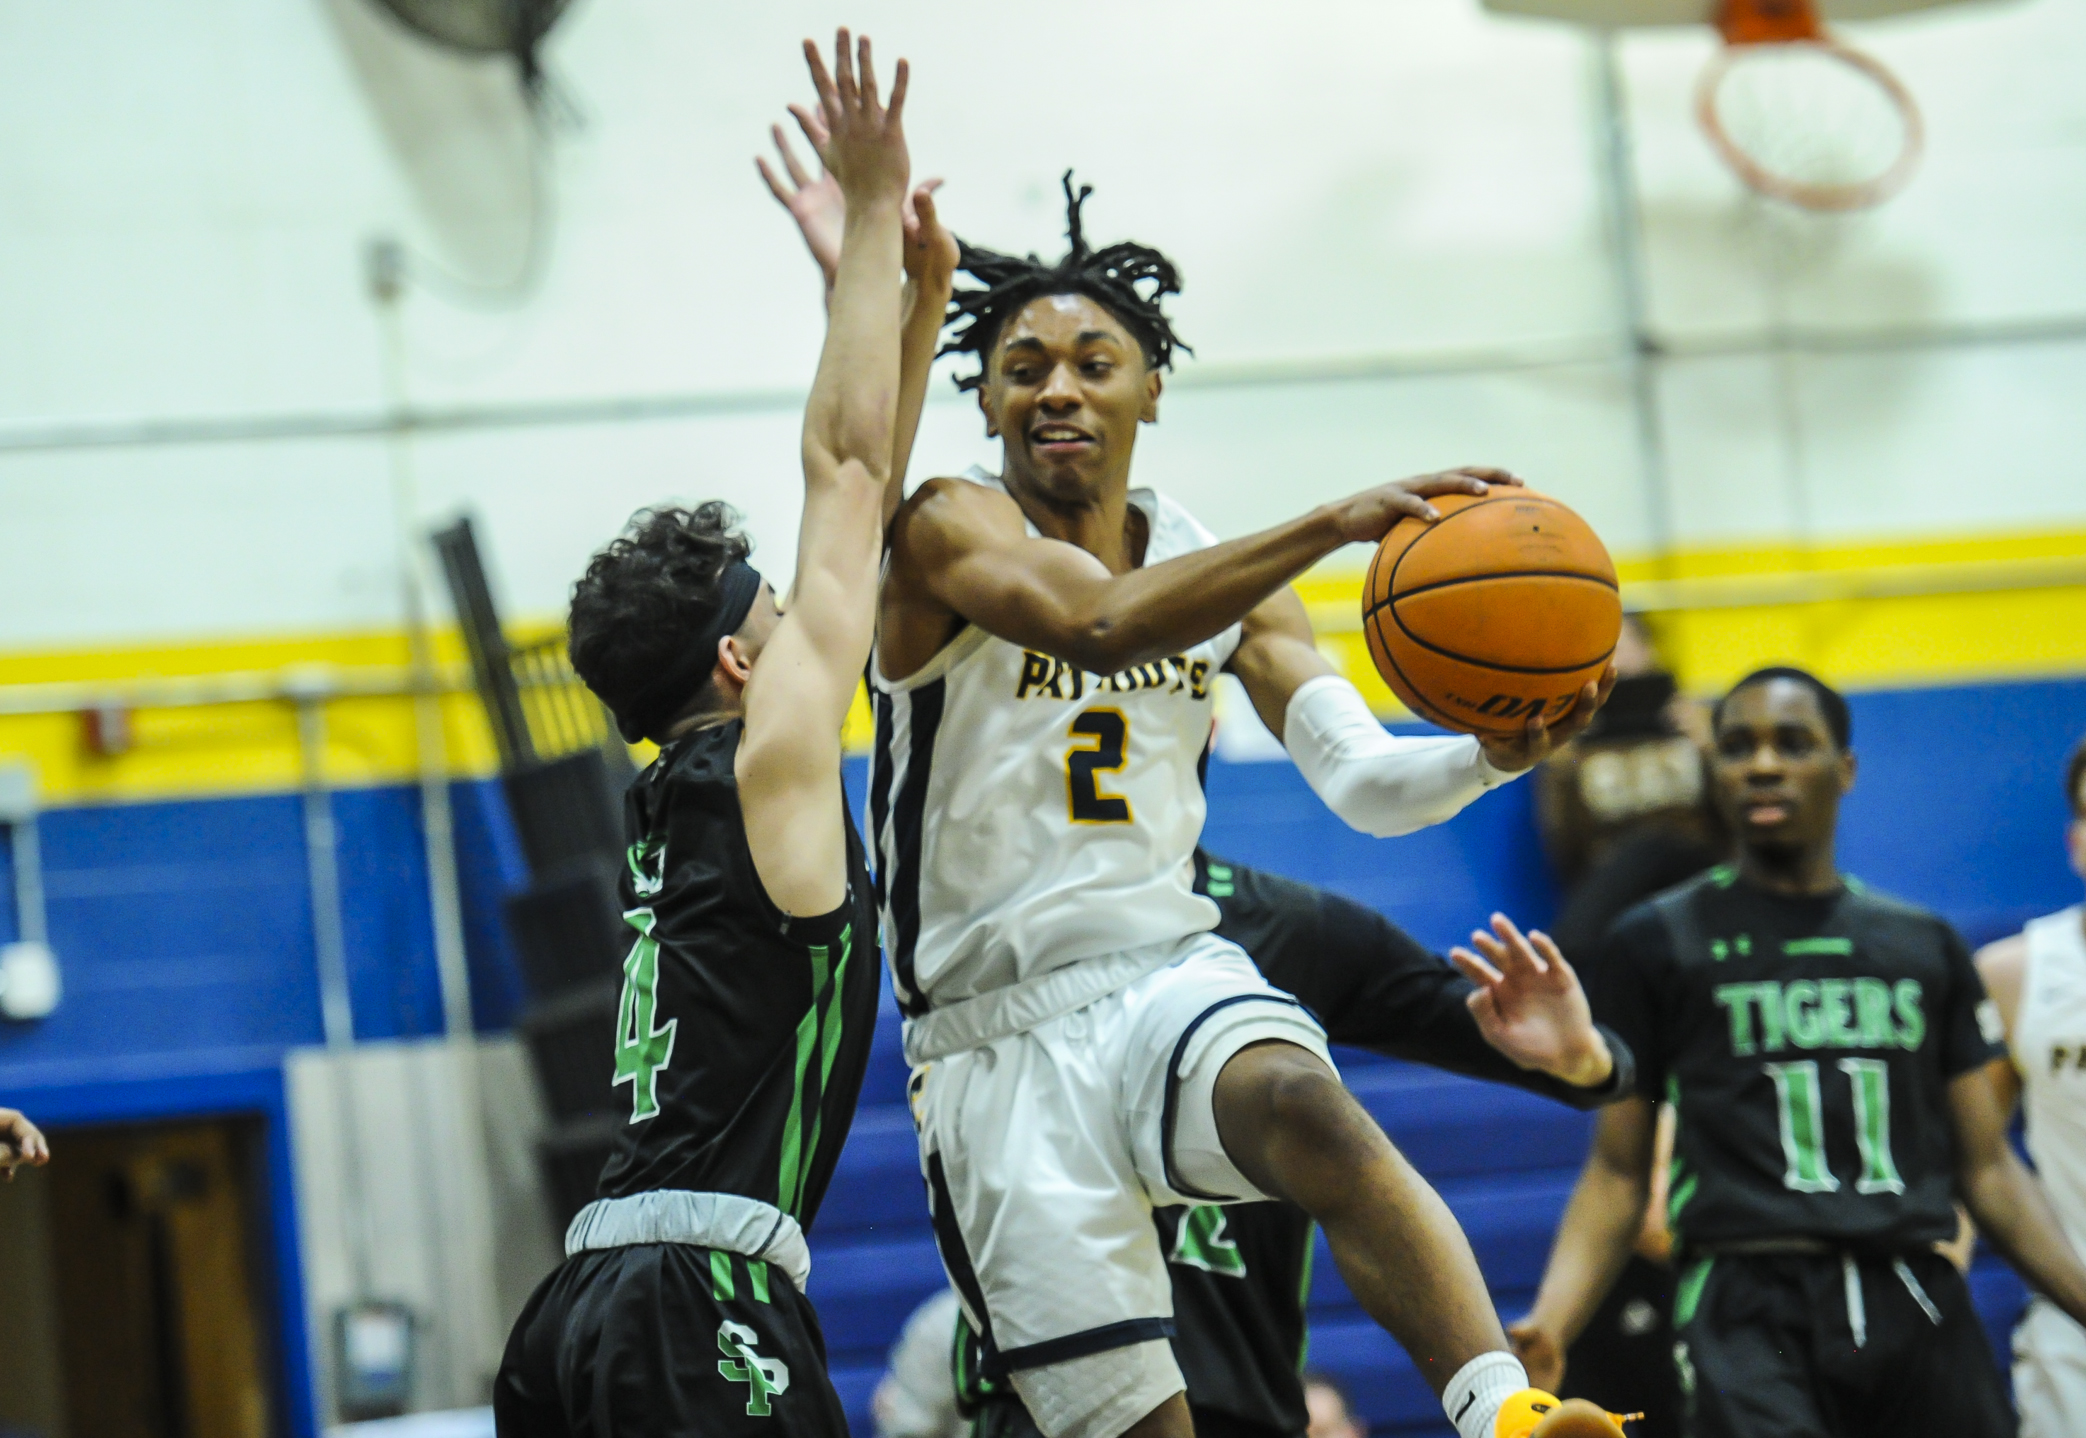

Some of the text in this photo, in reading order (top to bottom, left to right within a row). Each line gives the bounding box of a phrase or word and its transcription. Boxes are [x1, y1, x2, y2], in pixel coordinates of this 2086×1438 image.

[1064, 705, 1134, 825] 2
[611, 906, 679, 1126] 4
[1713, 976, 1927, 1057] TIGERS
[1761, 1056, 1907, 1197] 11
[717, 1319, 790, 1417] SP
